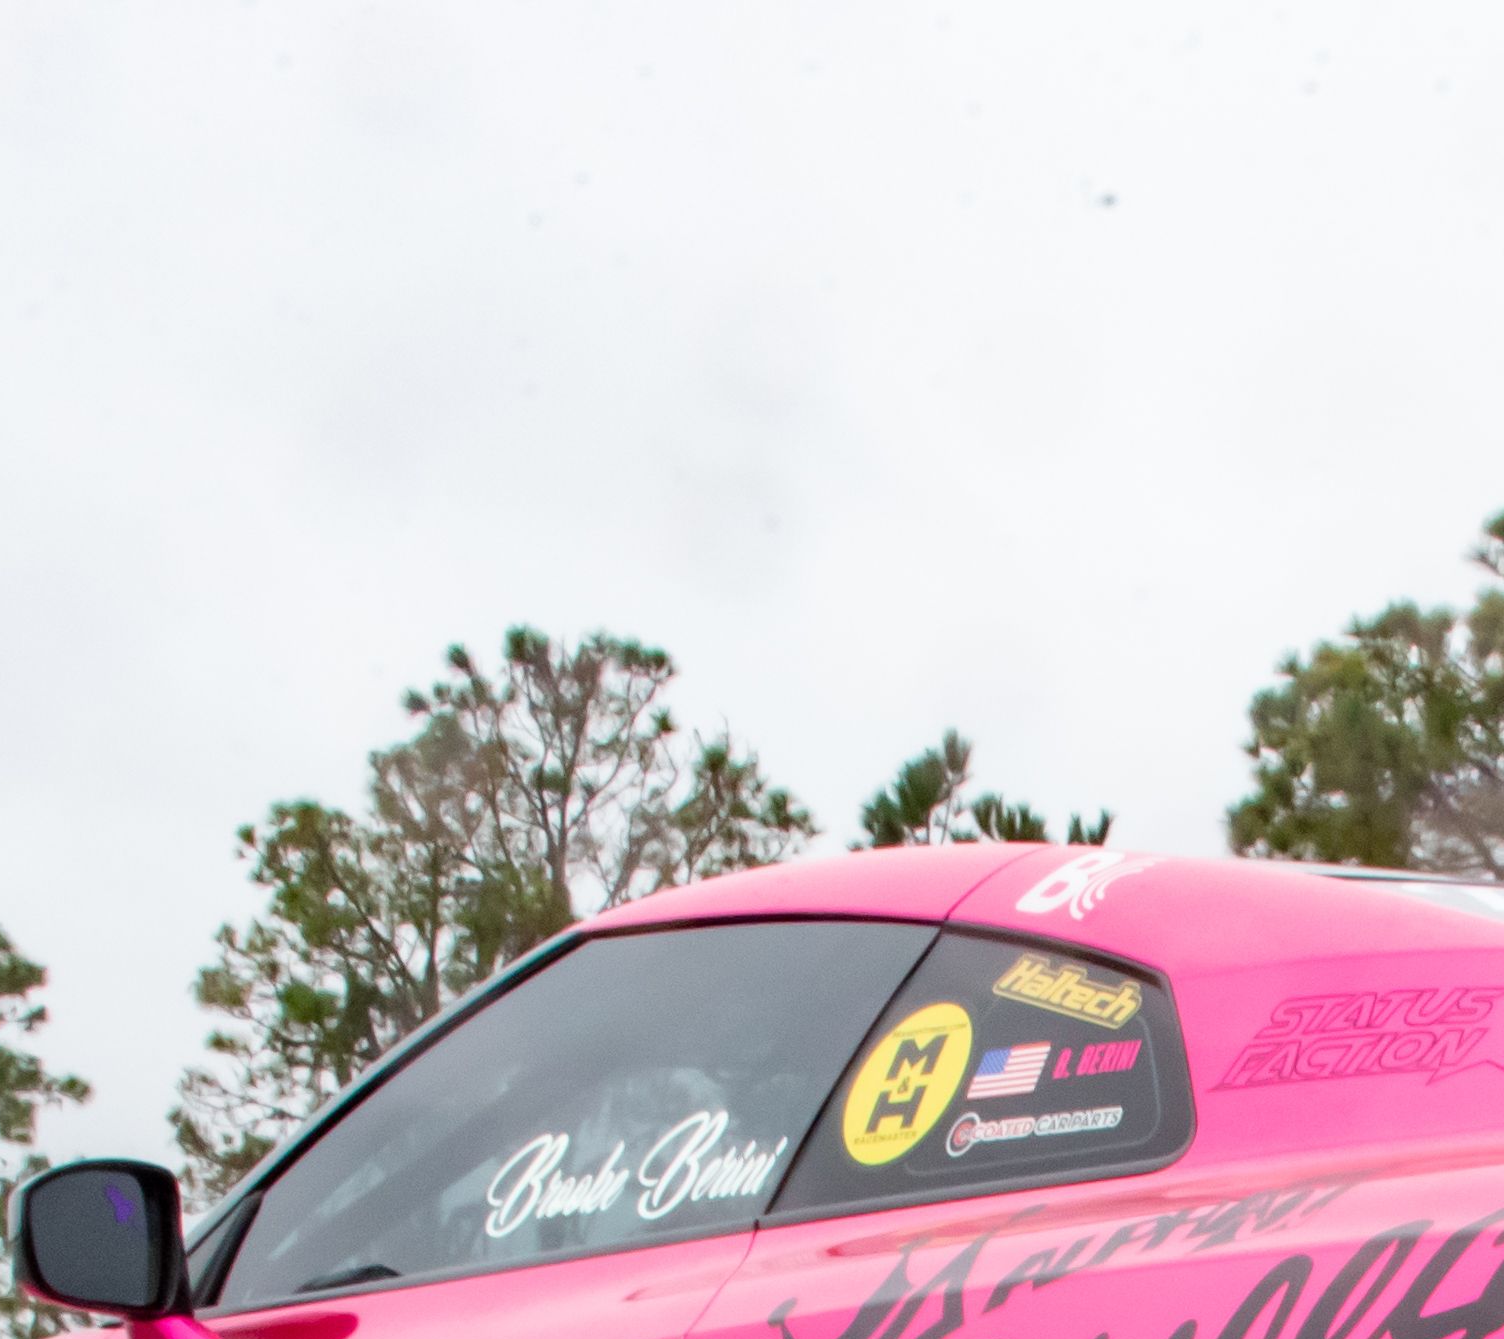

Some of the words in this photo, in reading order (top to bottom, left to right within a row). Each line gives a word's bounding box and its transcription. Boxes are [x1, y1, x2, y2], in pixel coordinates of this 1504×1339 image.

[998, 959, 1138, 1022] Haltech
[1208, 1027, 1488, 1091] FACTION
[486, 1133, 629, 1238] Brooke
[638, 1110, 788, 1219] Berini
